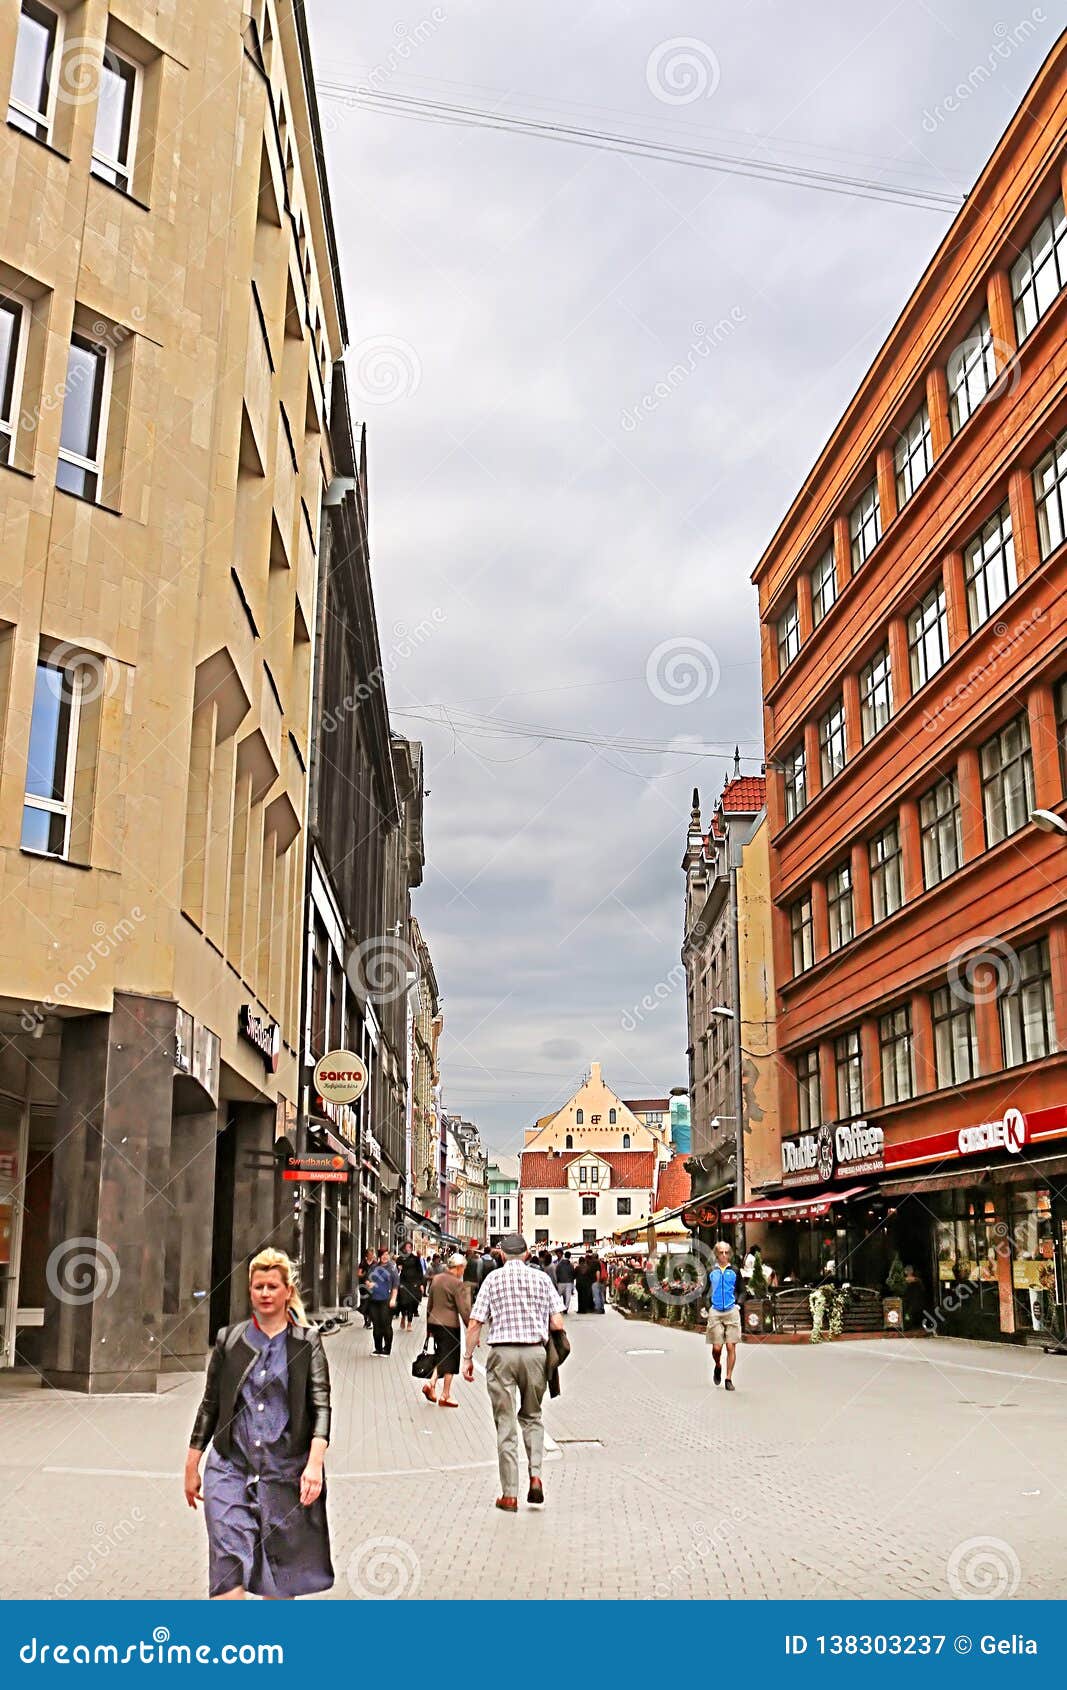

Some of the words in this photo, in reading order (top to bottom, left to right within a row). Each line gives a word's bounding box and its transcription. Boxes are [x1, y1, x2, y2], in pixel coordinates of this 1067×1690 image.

[781, 1135, 819, 1173] Double
[835, 1120, 884, 1163] Coffee
[958, 1120, 1005, 1154] CIRCLE
[288, 1157, 331, 1166] Swedbank
